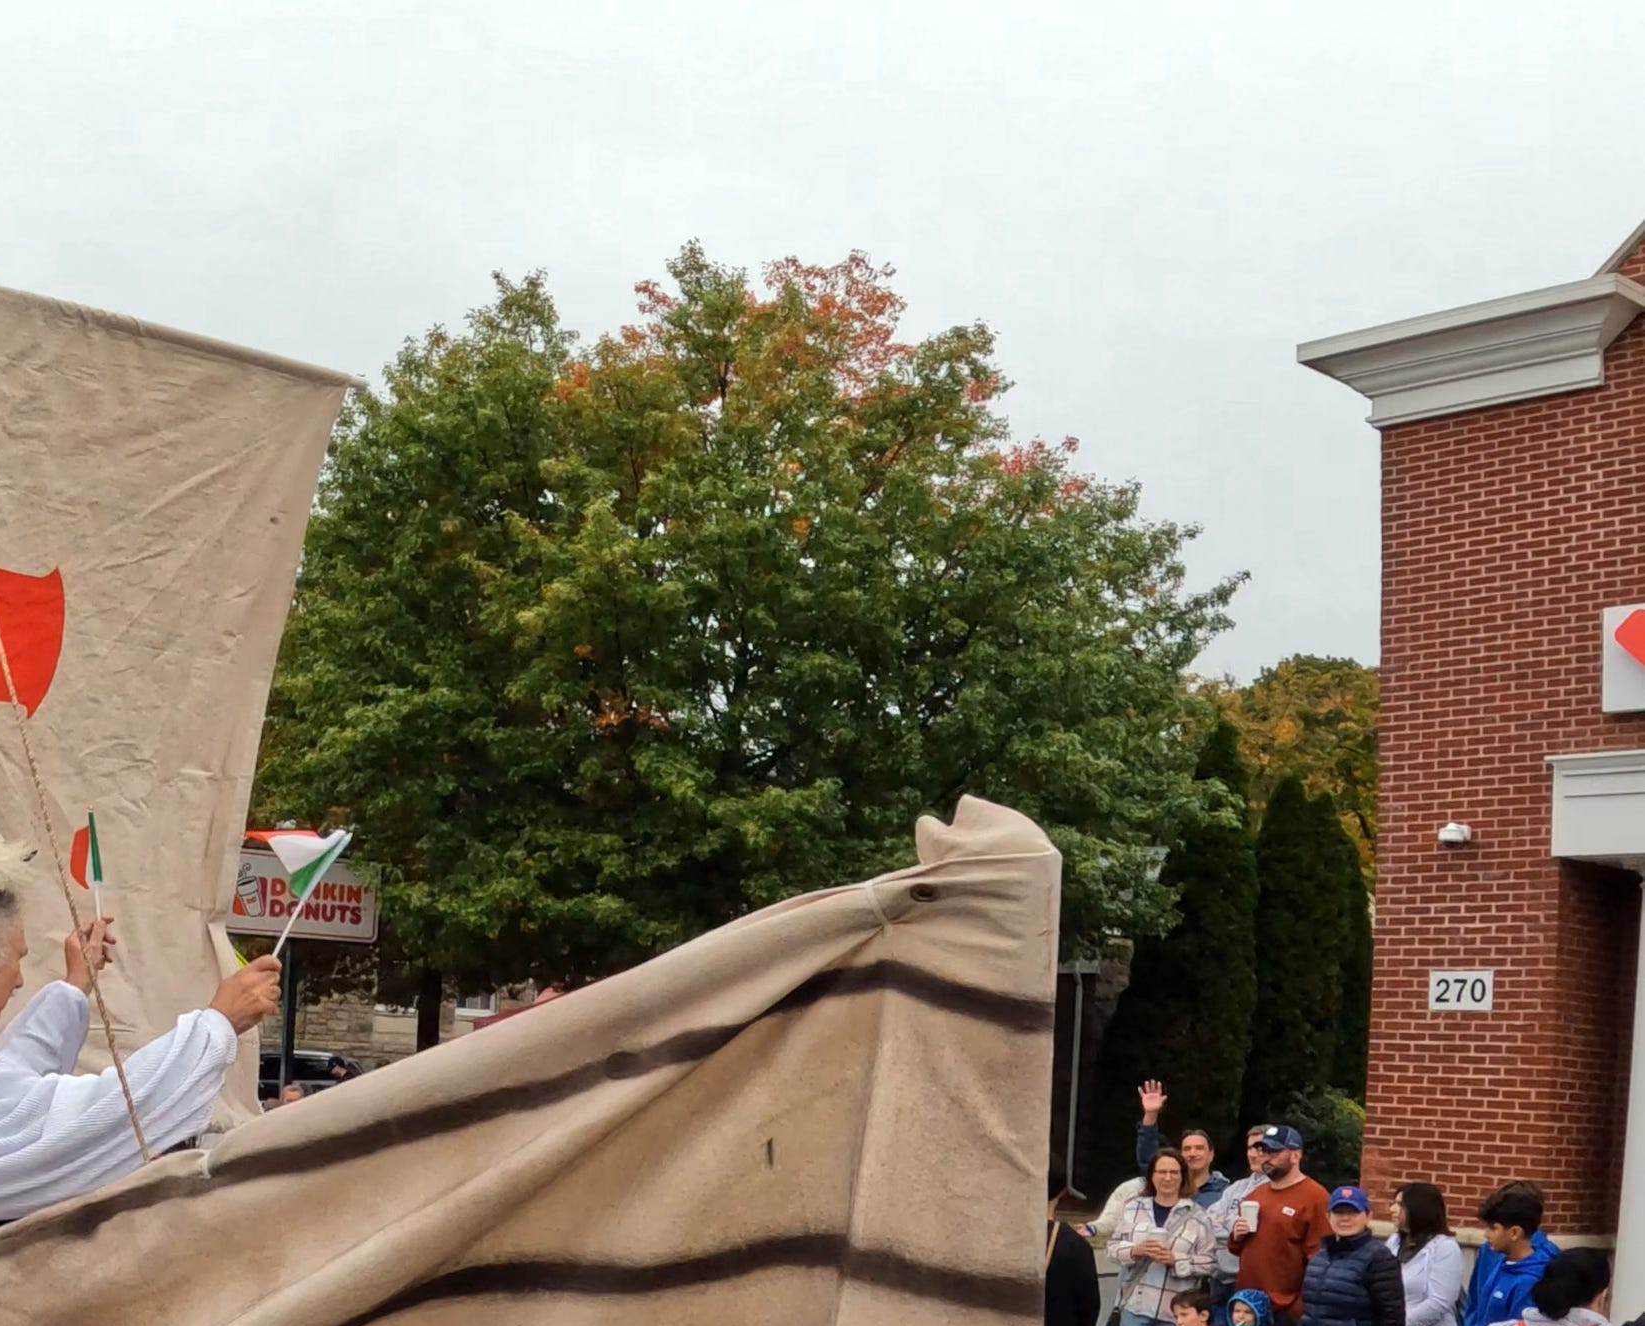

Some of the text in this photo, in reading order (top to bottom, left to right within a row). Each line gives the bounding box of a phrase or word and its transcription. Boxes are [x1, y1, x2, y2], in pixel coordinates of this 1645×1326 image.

[270, 877, 369, 904] DNKIN'
[269, 899, 362, 925] DONUTS
[1434, 978, 1487, 1004] 270
